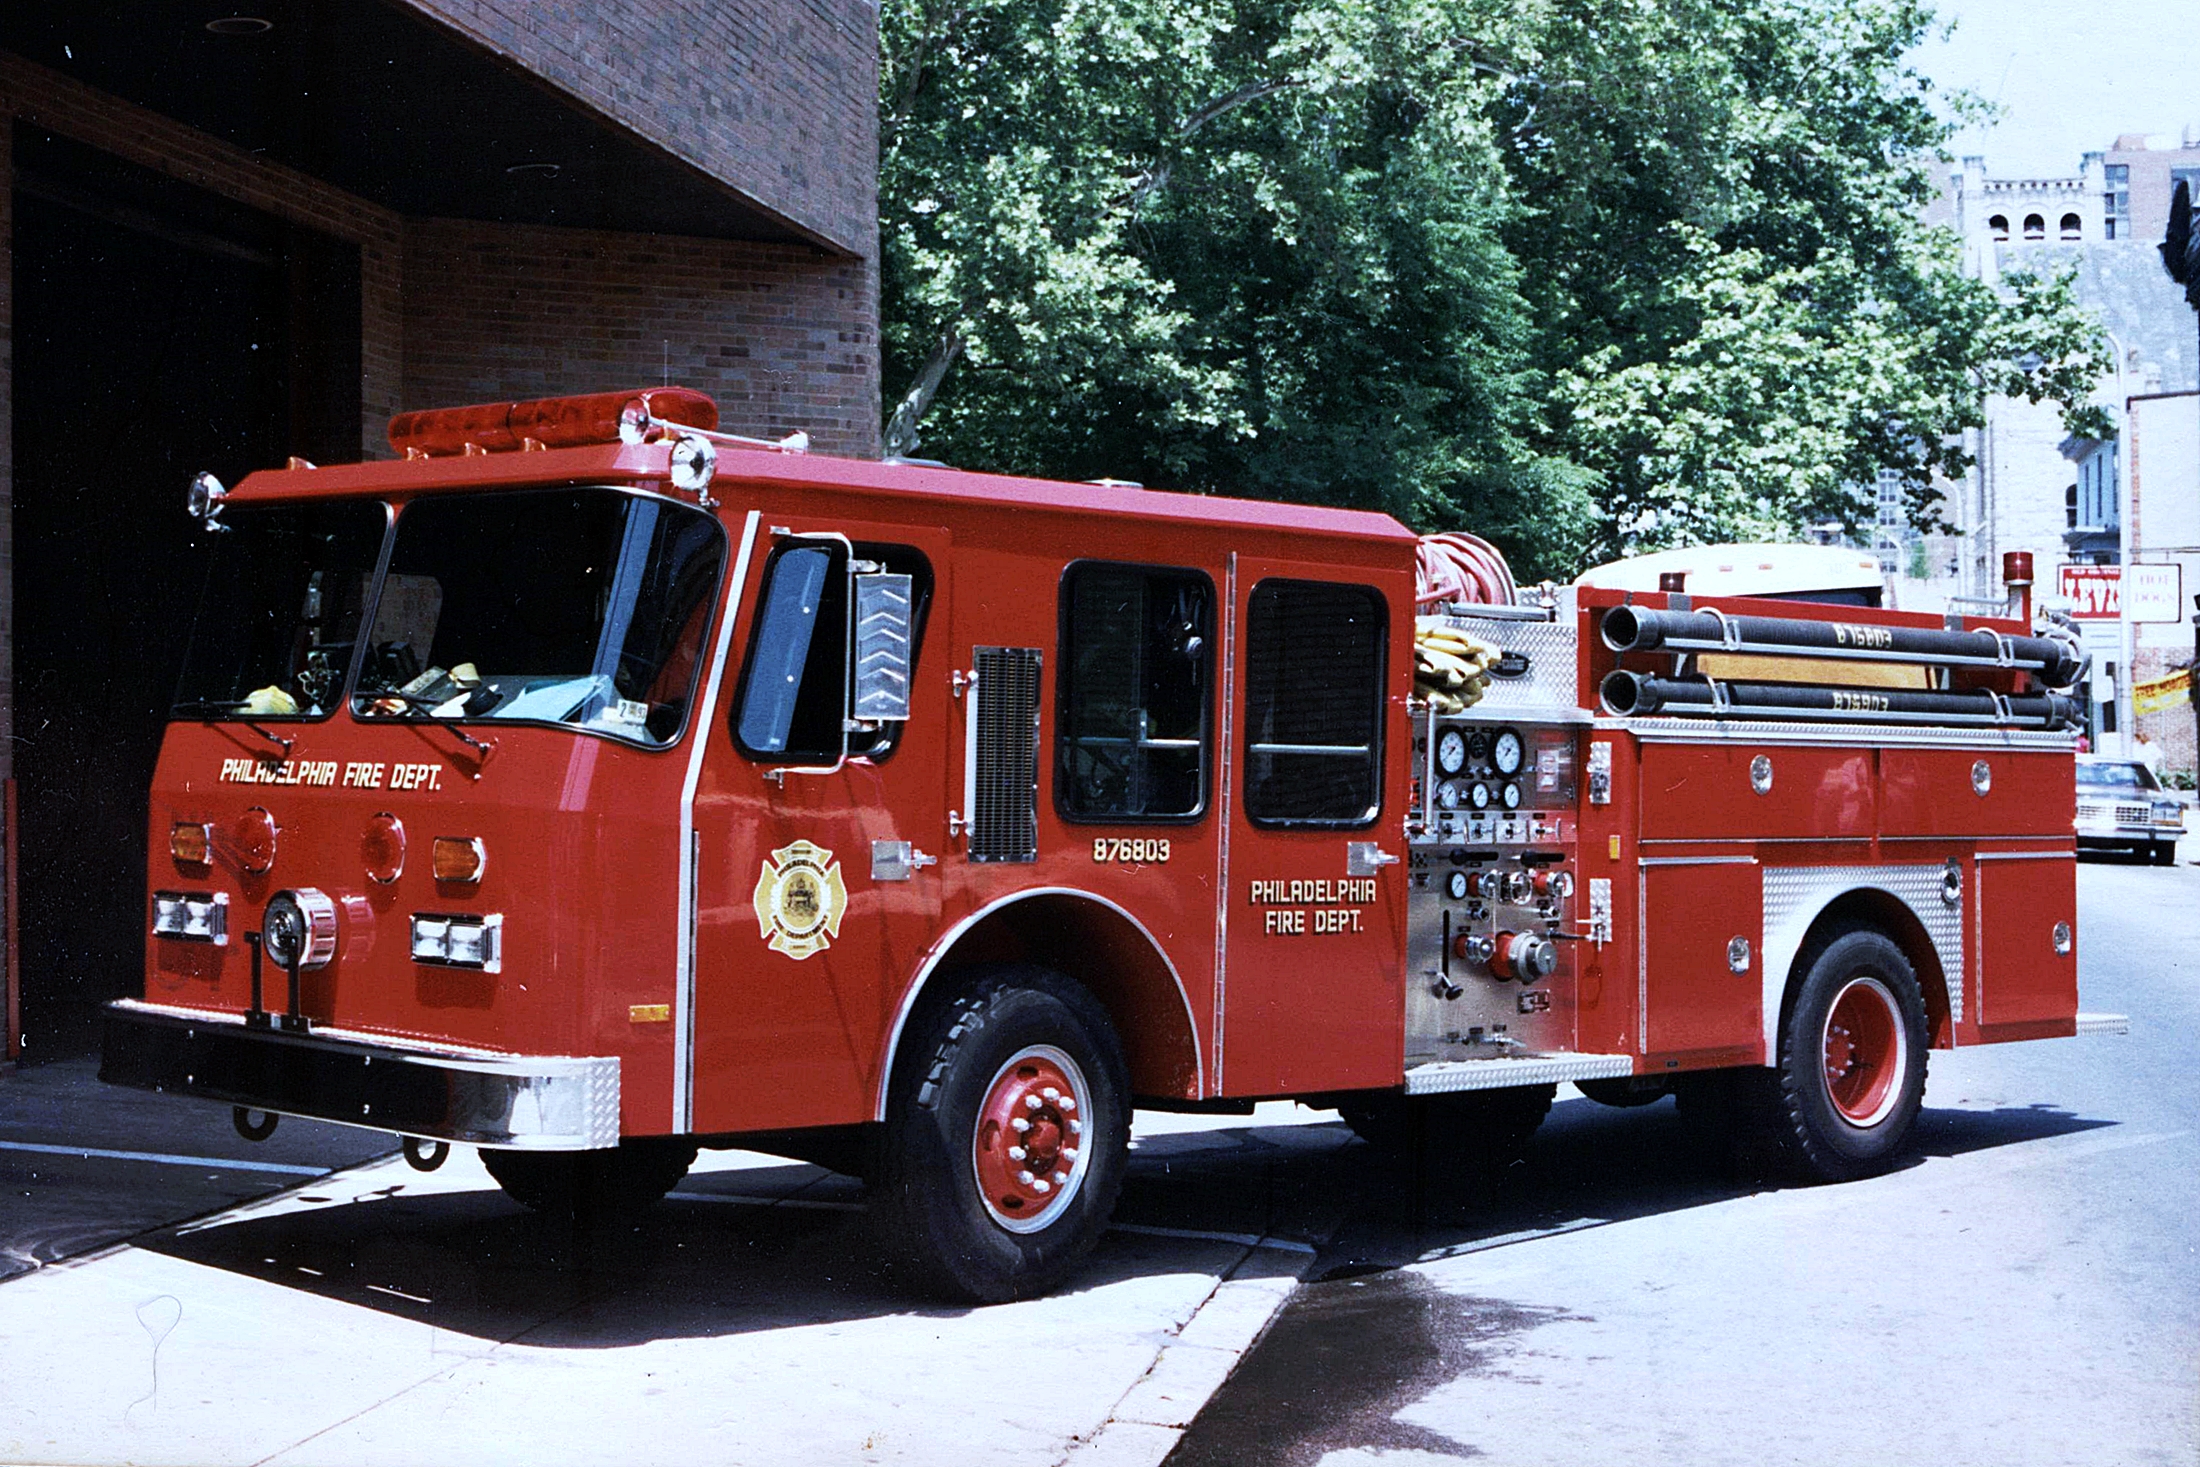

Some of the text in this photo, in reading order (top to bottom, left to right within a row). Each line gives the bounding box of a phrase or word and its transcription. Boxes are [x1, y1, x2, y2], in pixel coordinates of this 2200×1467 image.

[219, 758, 442, 790] PHILADELPHIA FIRE DEPT.
[1092, 838, 1171, 862] 876803
[1250, 879, 1377, 903] PHILADELPHIA
[1264, 908, 1364, 934] FIRE DEPT.
